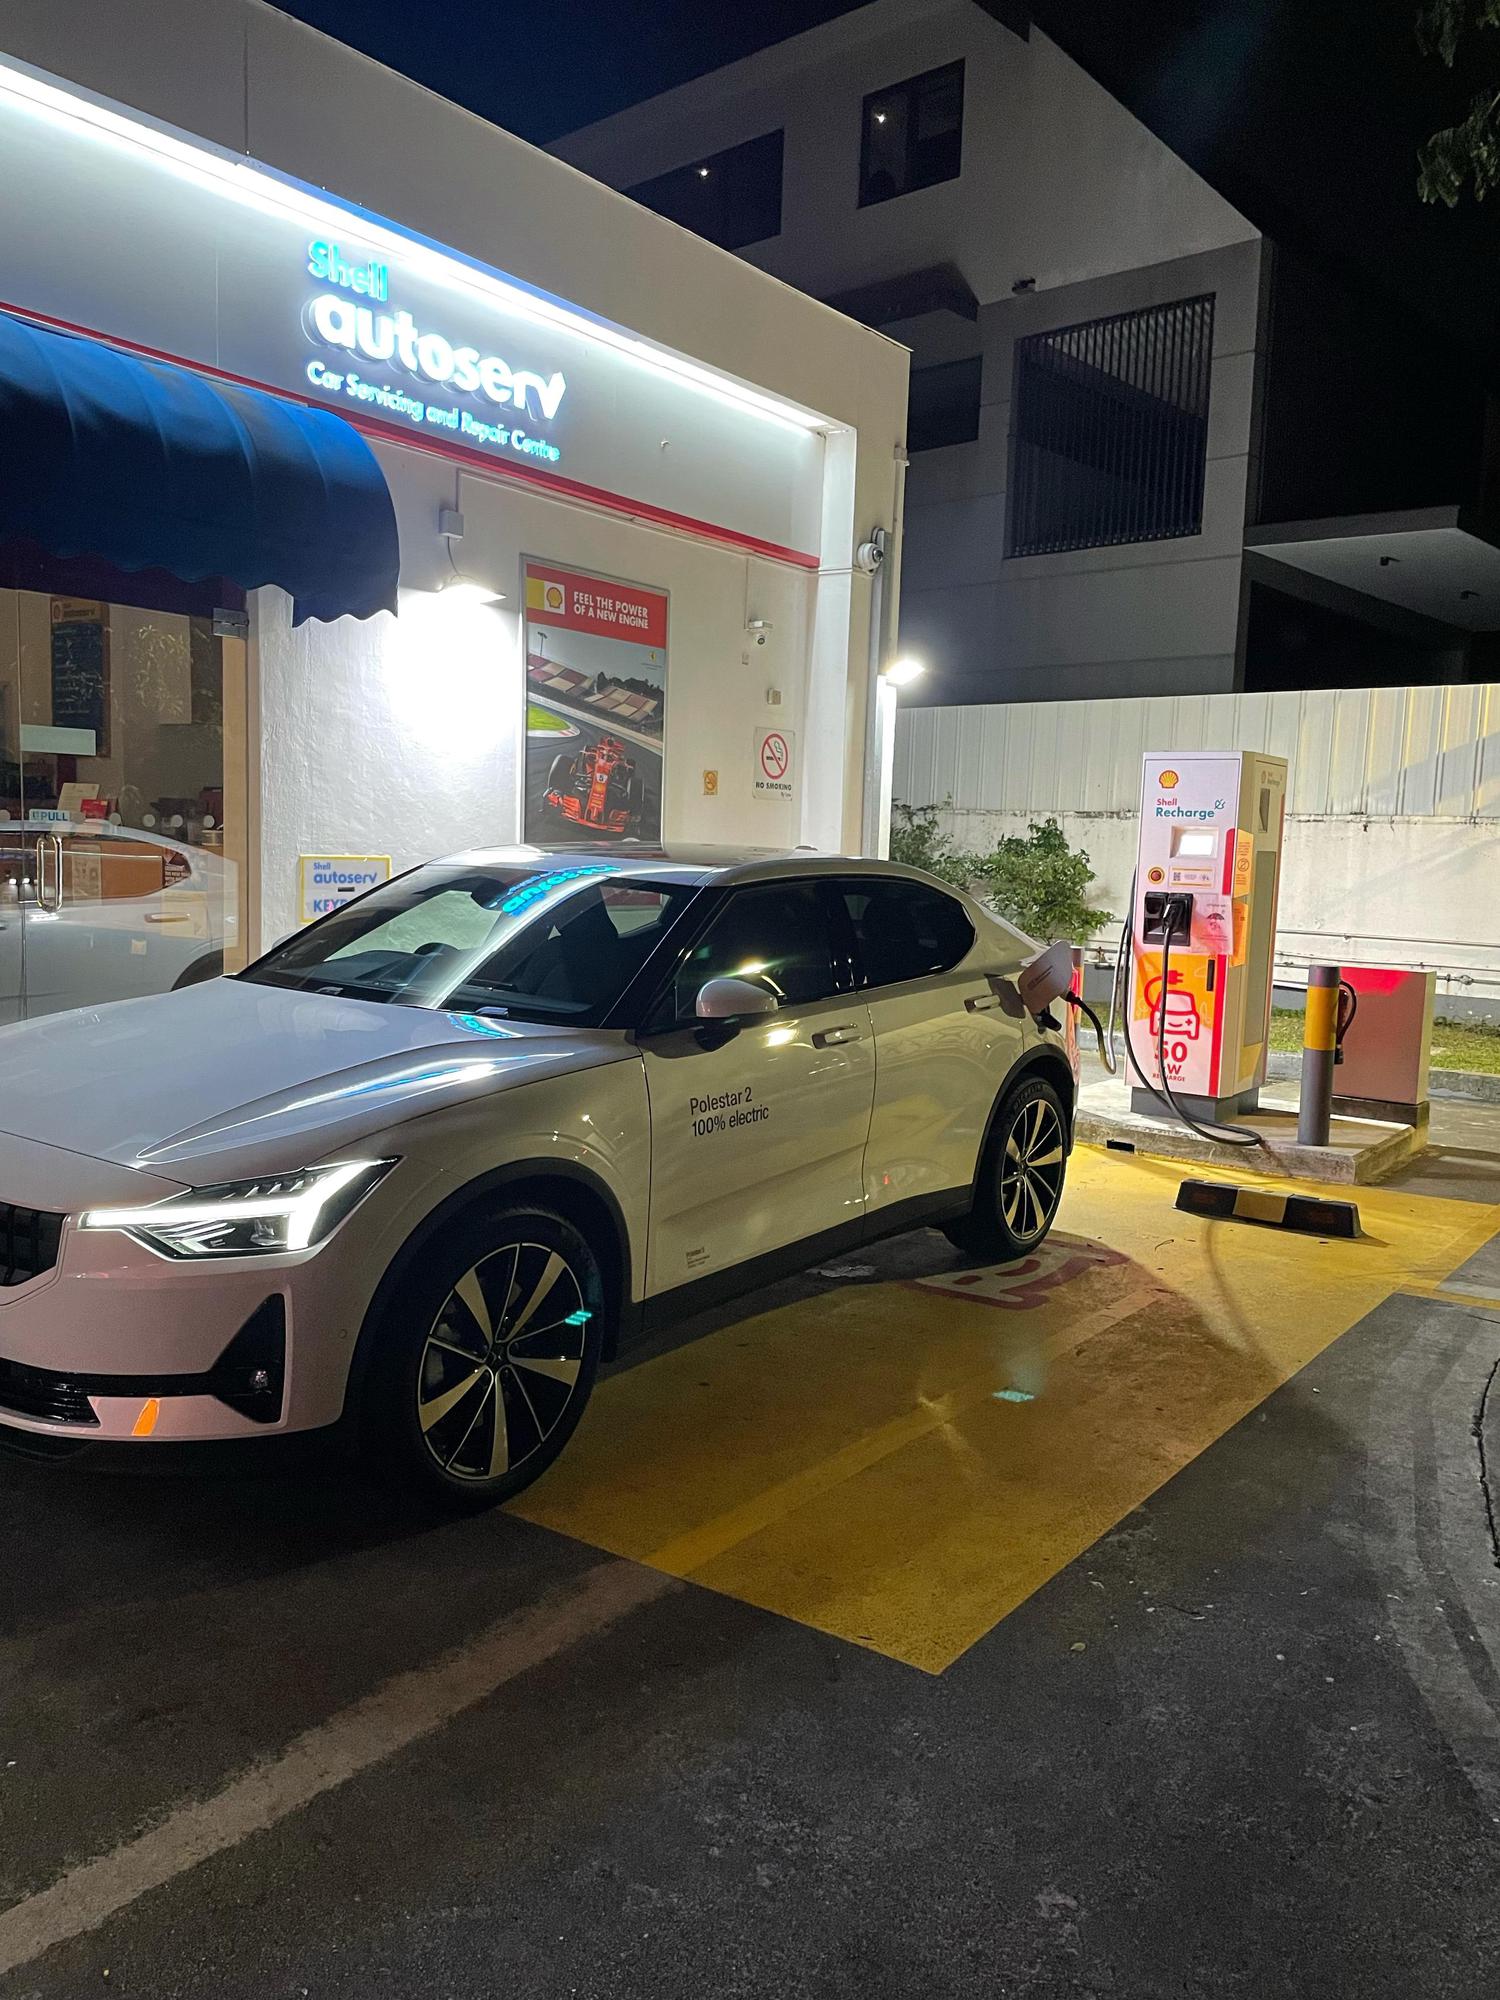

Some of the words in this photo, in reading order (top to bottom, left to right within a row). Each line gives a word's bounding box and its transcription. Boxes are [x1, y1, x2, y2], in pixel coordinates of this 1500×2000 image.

[307, 240, 388, 302] Shell
[306, 293, 567, 421] autoserv
[306, 361, 345, 391] Car
[346, 373, 425, 422] Servicing
[425, 406, 459, 429] and
[461, 411, 511, 446] Repair
[511, 429, 561, 462] Centre
[573, 591, 594, 606] FEEL
[596, 596, 613, 611] THE
[615, 601, 648, 619] POWER
[573, 603, 586, 616] OF
[587, 607, 595, 618] A
[596, 608, 617, 623] NEW
[618, 613, 649, 629] ENGINE
[755, 781, 765, 789] NO
[766, 782, 792, 791] SMOKING
[1155, 806, 1215, 821] Recharge
[1156, 798, 1178, 806] Shell
[40, 811, 68, 821] PULL
[313, 862, 331, 870] Shell
[313, 872, 378, 884] autoserv
[690, 1092, 743, 1116] Polestar
[744, 1086, 753, 1103] 2
[692, 1113, 726, 1137] 100%
[728, 1104, 770, 1128] electric
